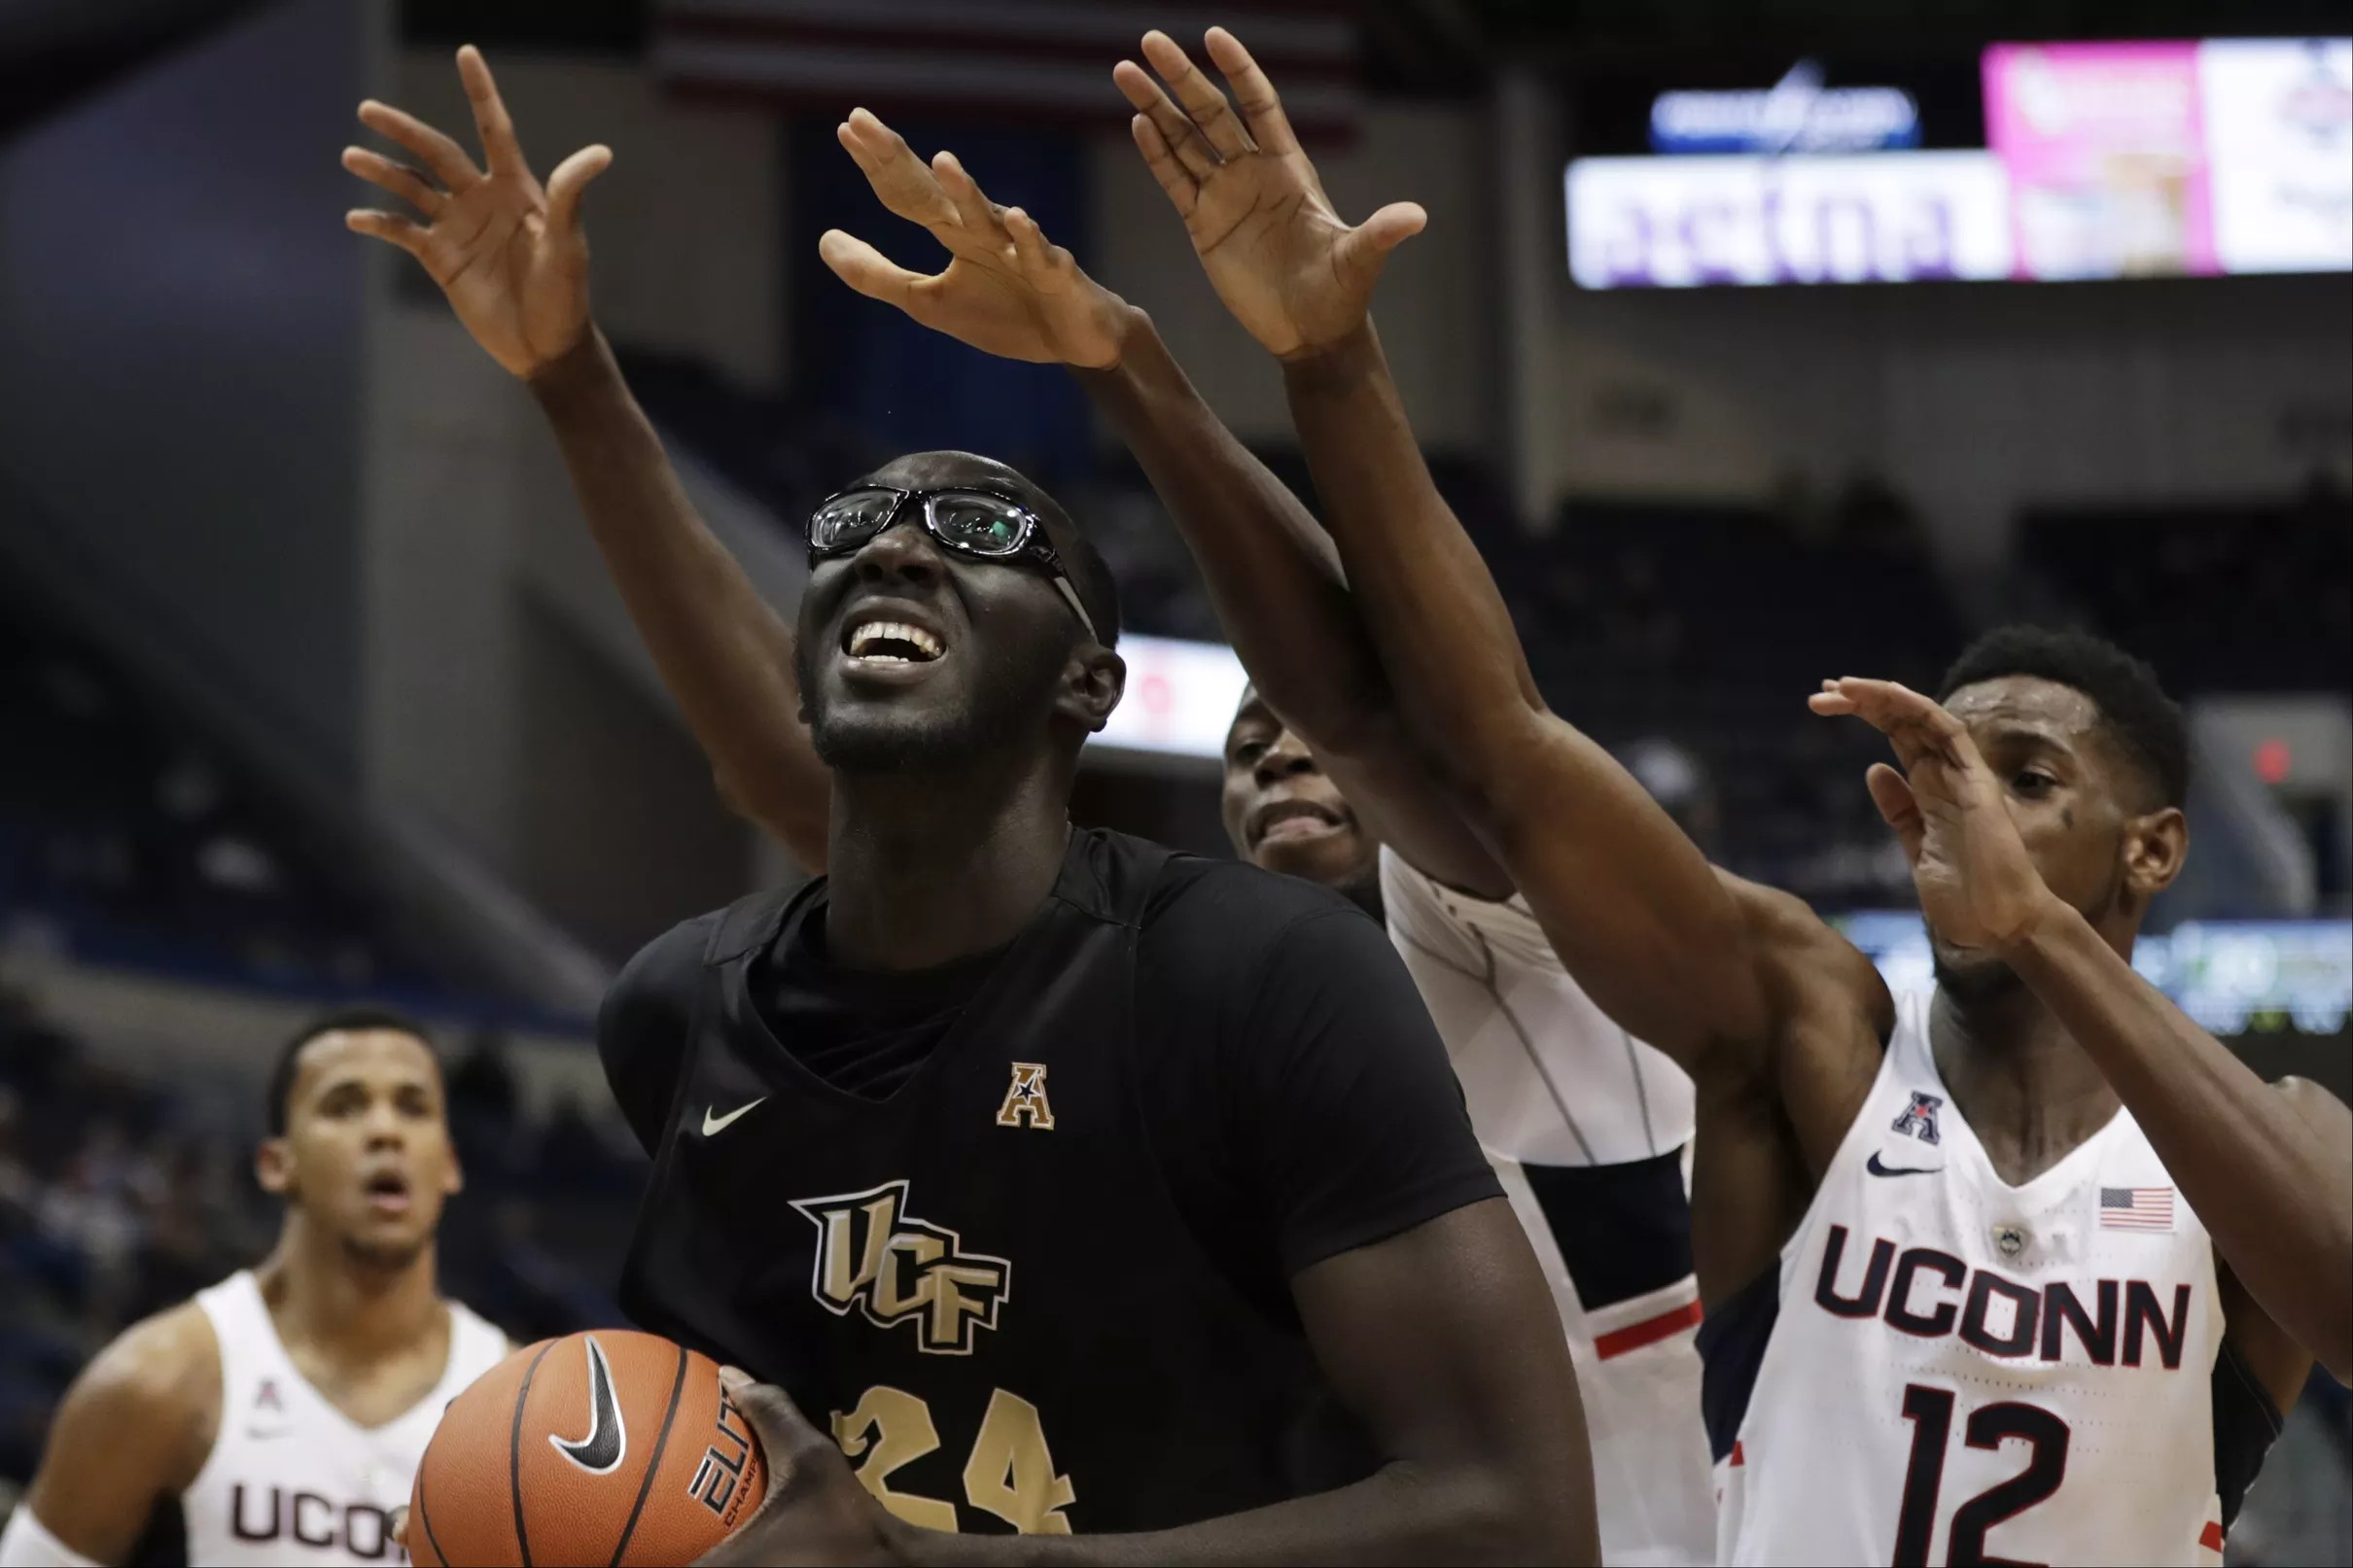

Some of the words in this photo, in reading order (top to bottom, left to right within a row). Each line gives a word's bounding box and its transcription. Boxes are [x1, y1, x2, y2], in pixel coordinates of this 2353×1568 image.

[996, 1062, 1055, 1131] A
[1891, 1090, 1944, 1146] A
[788, 1179, 1011, 1355] UCF
[1815, 1224, 2192, 1370] UCONN
[232, 1483, 406, 1563] UCO
[829, 1384, 1076, 1536] 24
[1891, 1383, 2071, 1567] 12
